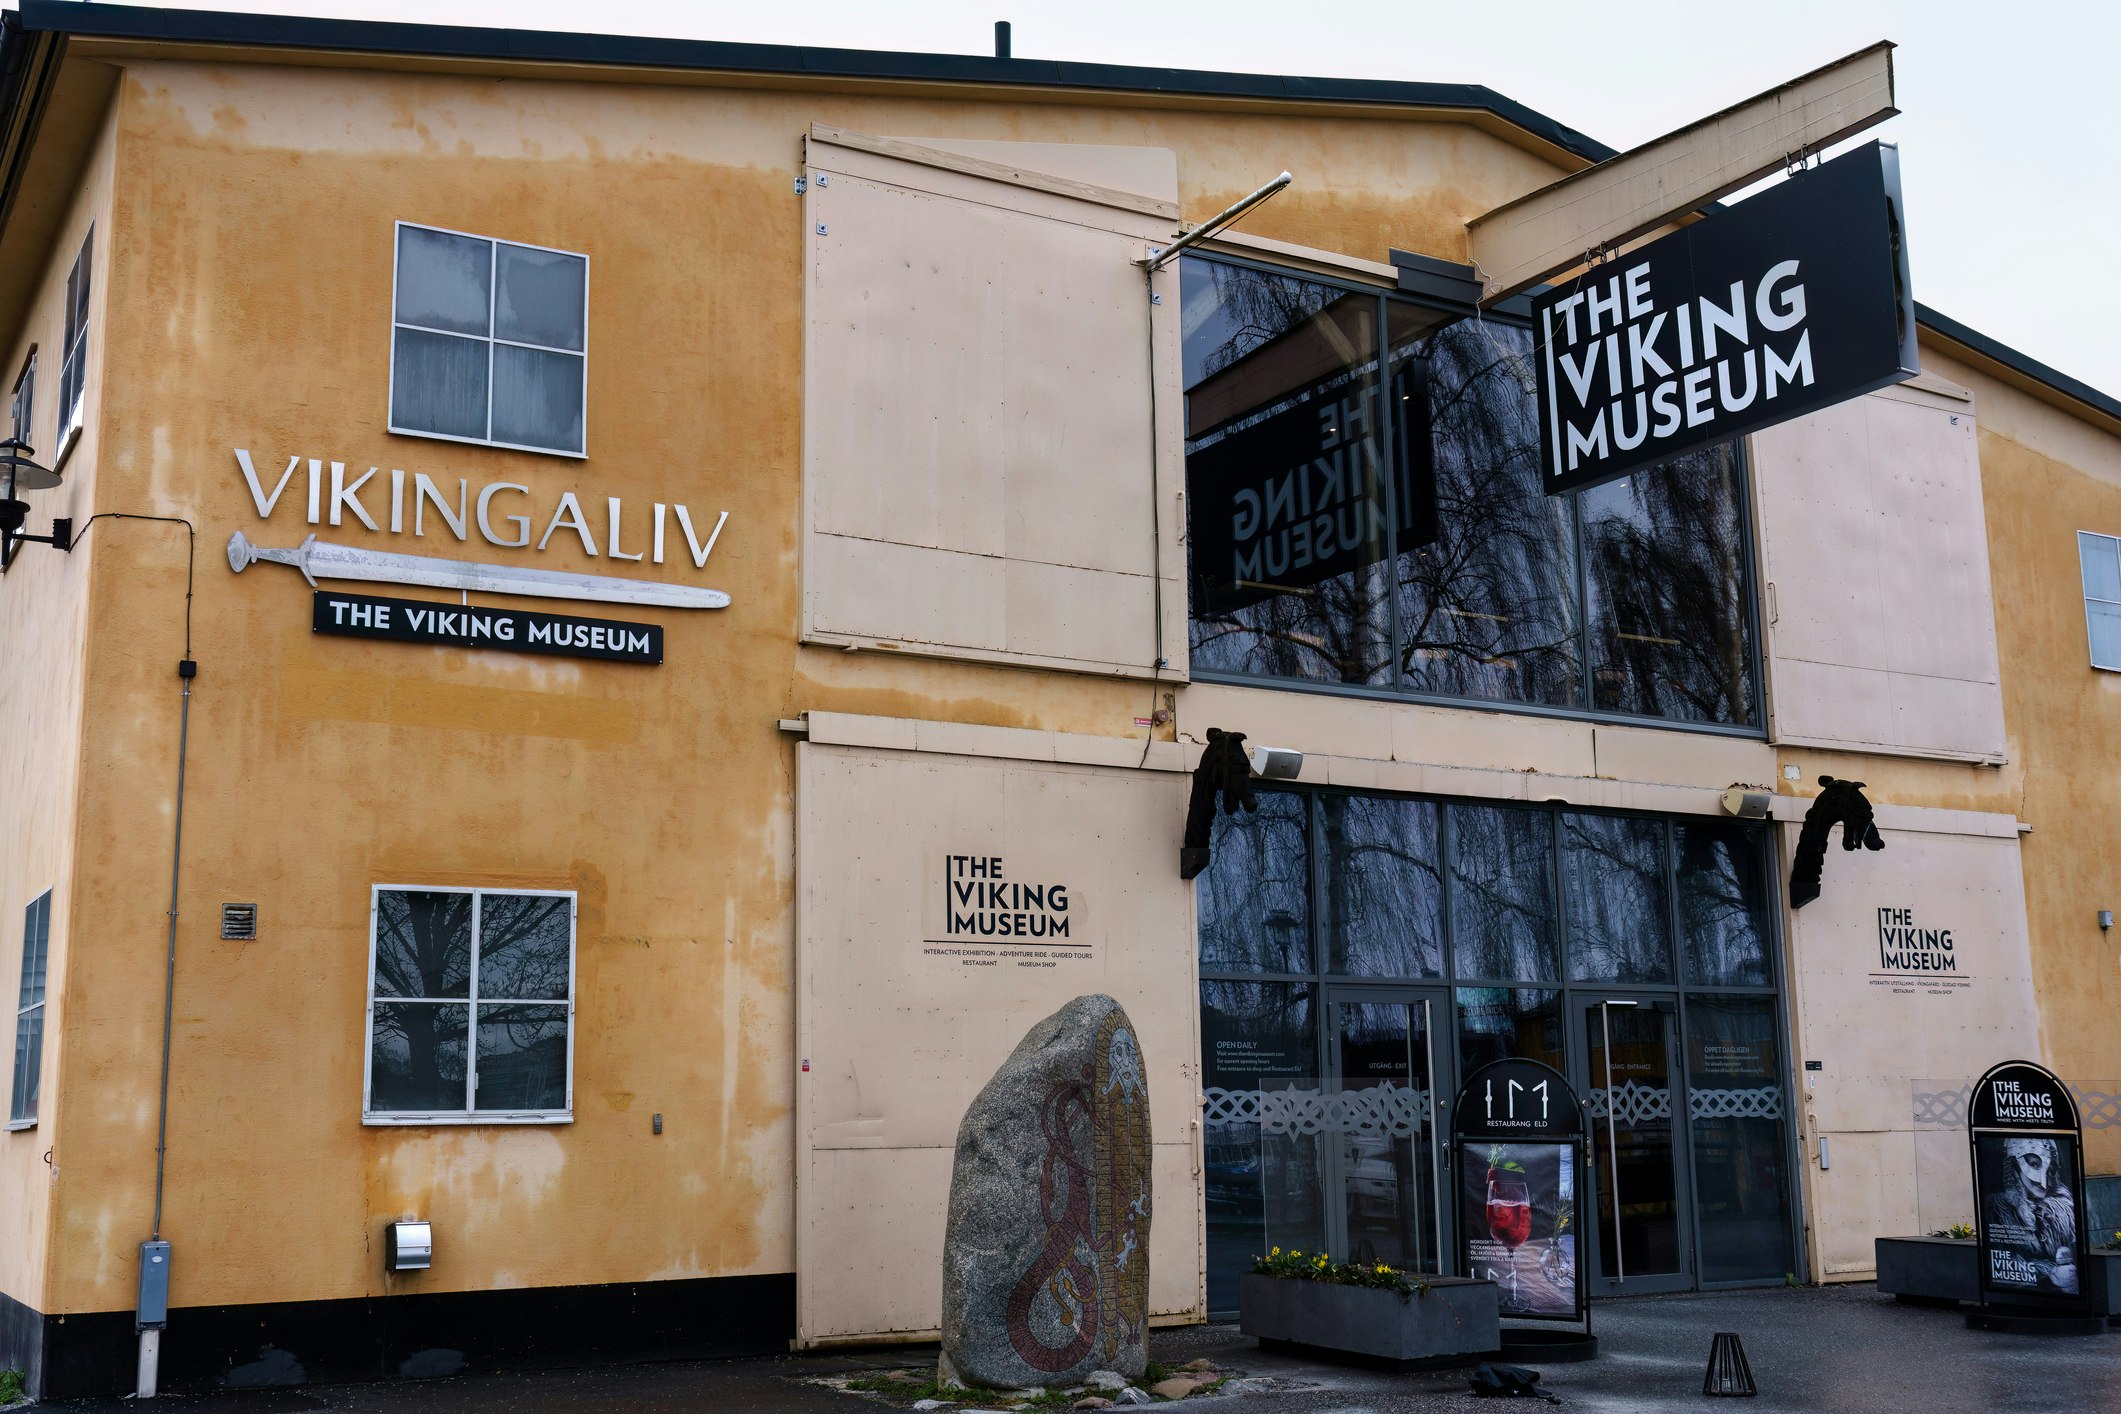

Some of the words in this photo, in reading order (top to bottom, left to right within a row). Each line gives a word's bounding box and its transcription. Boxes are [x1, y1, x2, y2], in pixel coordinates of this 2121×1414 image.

[1554, 261, 1653, 346] THE
[1558, 259, 1807, 409] VIKING
[1567, 328, 1815, 471] MUSEUM
[234, 448, 729, 568] VIKINGALIV
[330, 601, 390, 629] THE
[405, 608, 515, 641] VIKING
[528, 620, 650, 654] MUSEUM
[953, 855, 1003, 879] THE
[953, 881, 1068, 912] VIKING
[954, 912, 1070, 938] MUSEUM
[1882, 908, 1912, 926] THE
[1883, 928, 1953, 951] VIKING
[923, 948, 961, 956] INTERACTIVE
[963, 949, 995, 957] EXHIBITION
[1885, 952, 1956, 971] MUSEUM
[1237, 1041, 1257, 1049] DAILY
[1368, 1061, 1392, 1069] UTGÅNG
[1996, 1081, 2020, 1092] THE
[1997, 1093, 2052, 1106] VIKING
[1999, 1106, 2054, 1119] MUSEUM
[1534, 1120, 1548, 1128] ELD
[1994, 1250, 2011, 1259] THE
[1994, 1259, 2036, 1273] VIKING
[1995, 1270, 2037, 1283] MUSEUM
